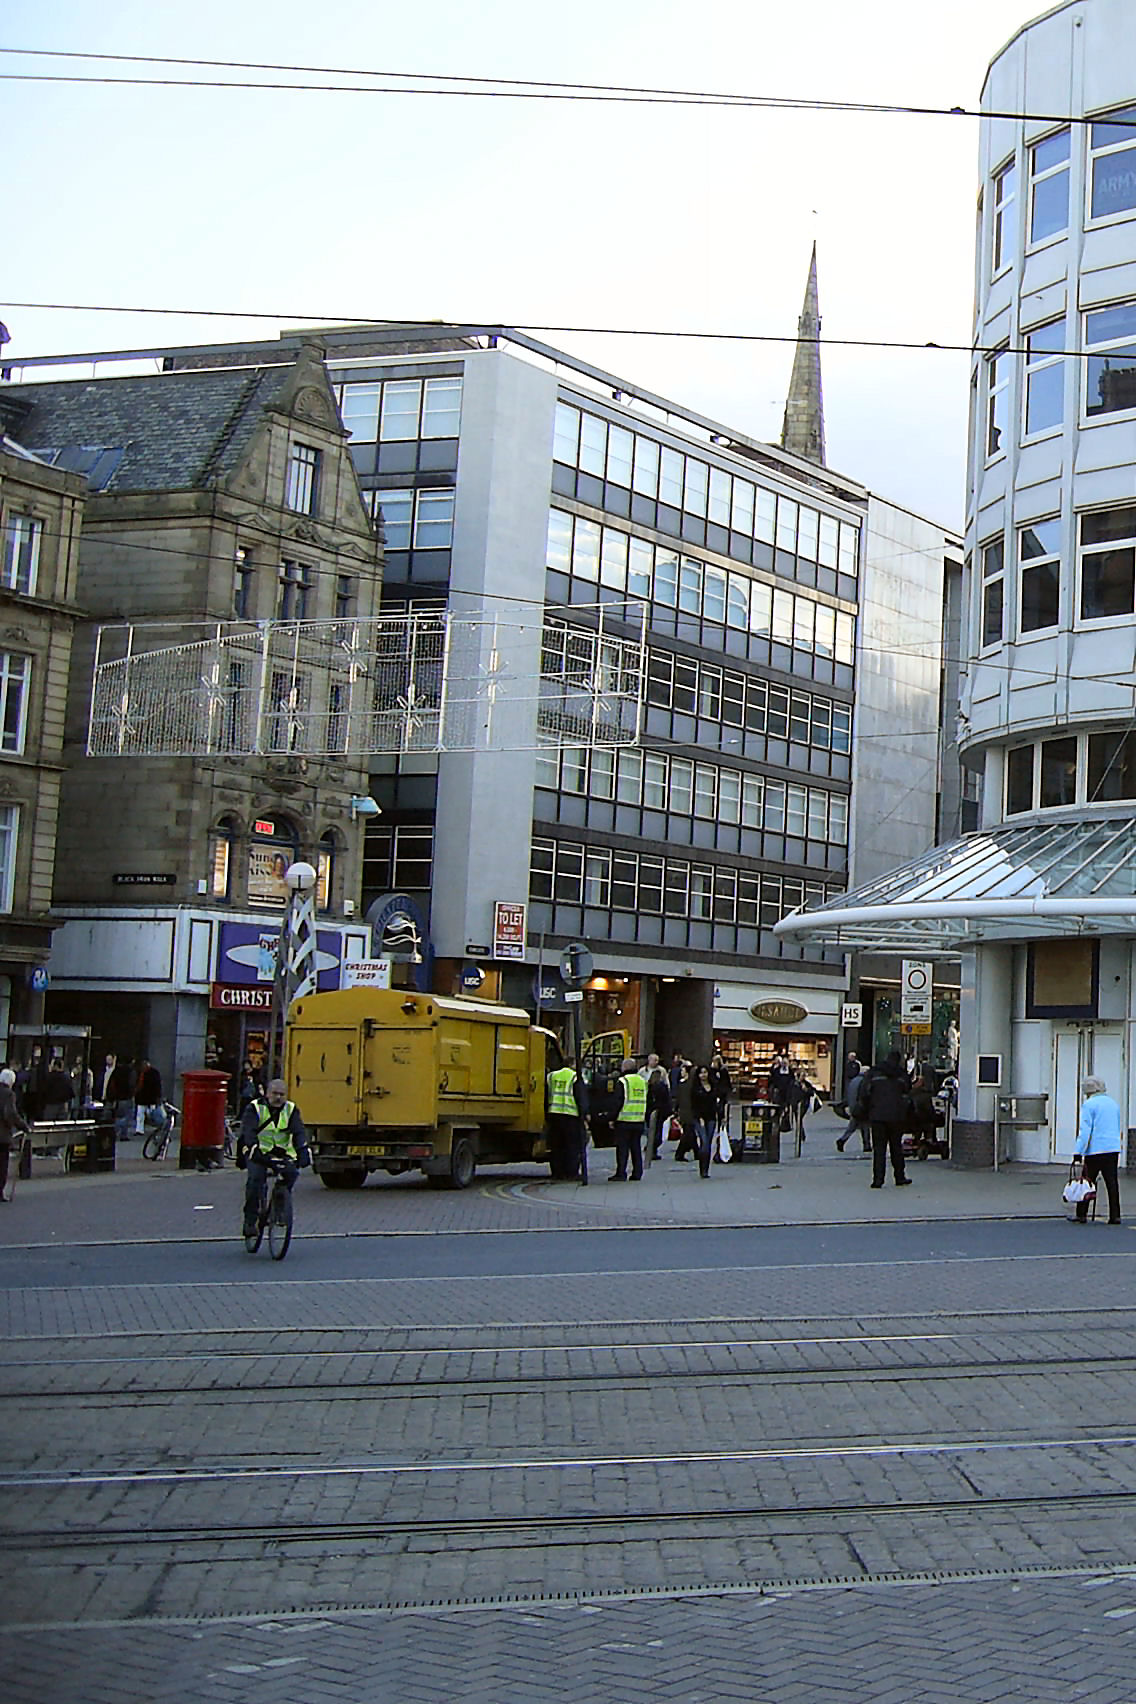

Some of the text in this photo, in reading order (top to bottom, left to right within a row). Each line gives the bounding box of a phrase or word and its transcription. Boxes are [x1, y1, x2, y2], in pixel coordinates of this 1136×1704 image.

[499, 911, 523, 926] TO LET
[345, 963, 388, 971] CHRISTMAS
[356, 972, 376, 980] SHOP
[464, 977, 480, 986] USC
[220, 988, 273, 1007] CHRIST
[539, 987, 556, 999] USC
[844, 1008, 859, 1019] HS
